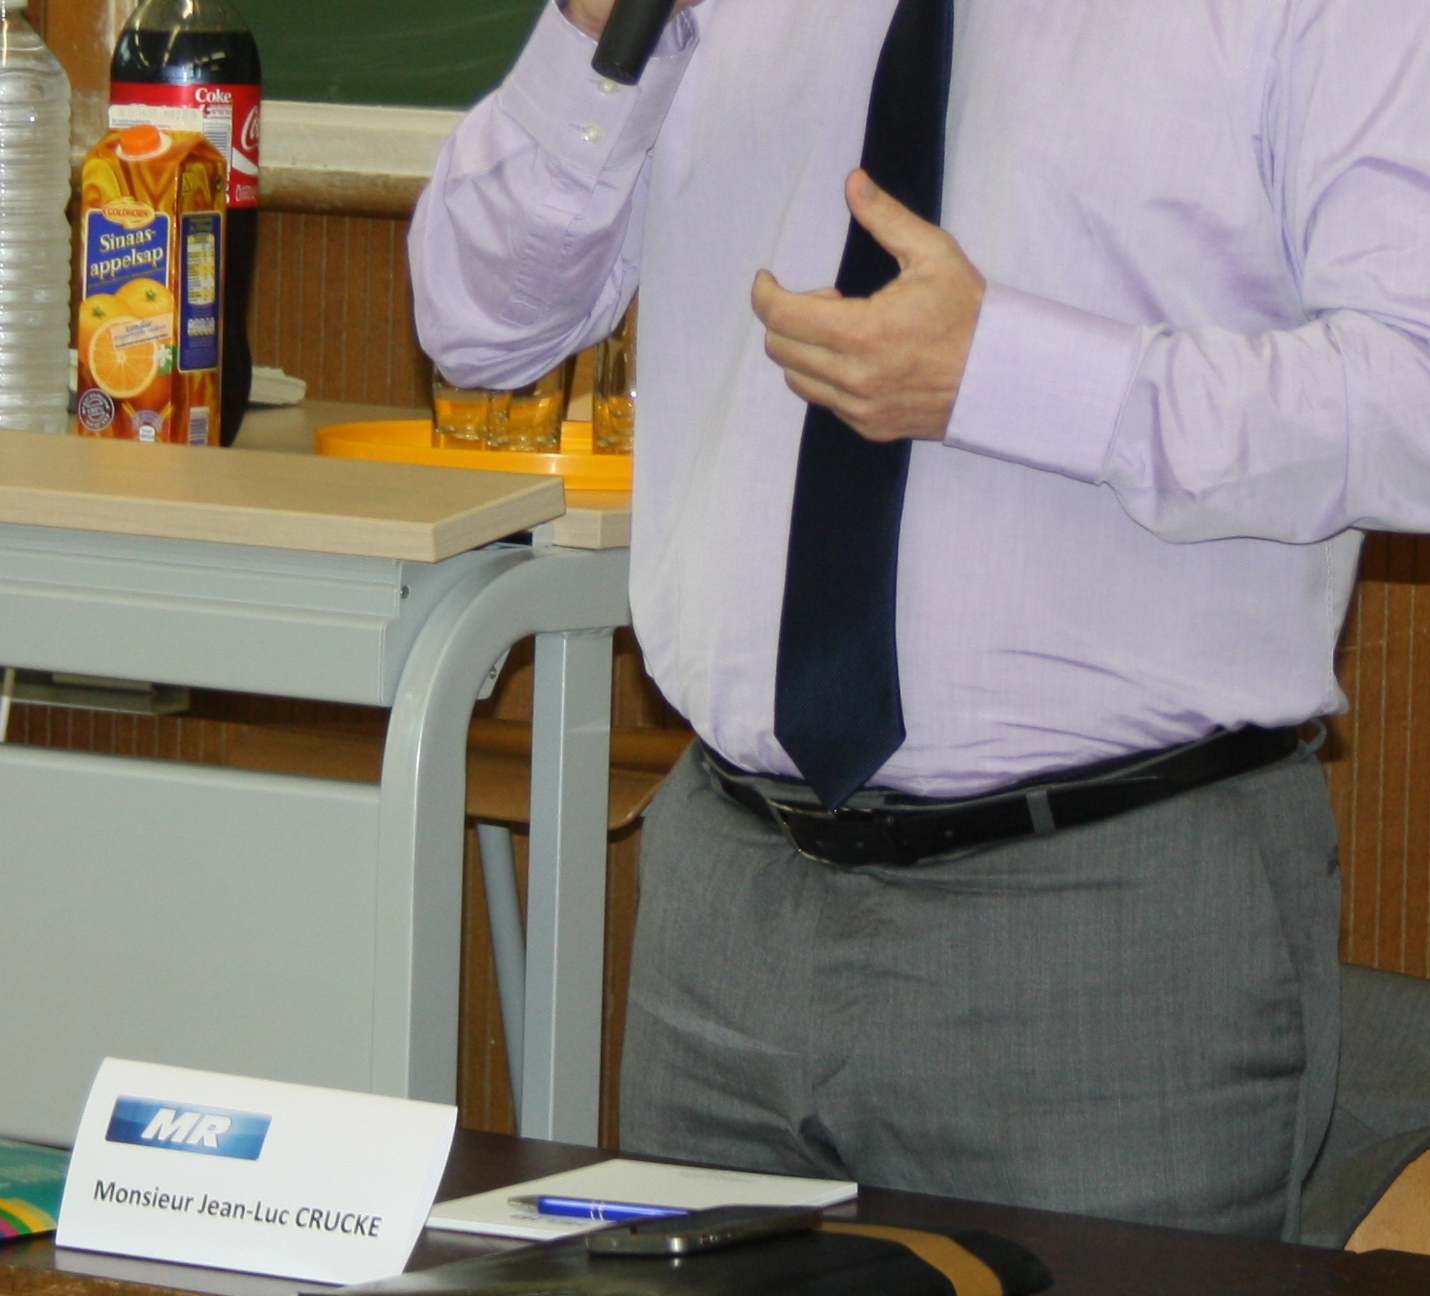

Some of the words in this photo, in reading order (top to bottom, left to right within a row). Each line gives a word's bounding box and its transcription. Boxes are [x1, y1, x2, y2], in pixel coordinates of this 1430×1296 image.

[195, 87, 231, 103] Coke
[100, 228, 156, 252] Sinaas-
[90, 247, 163, 279] appelsap
[141, 1107, 232, 1149] MR
[93, 1179, 194, 1214] Monsieur
[197, 1193, 289, 1225] Jean-Luc
[295, 1206, 382, 1238] CRUCKE
